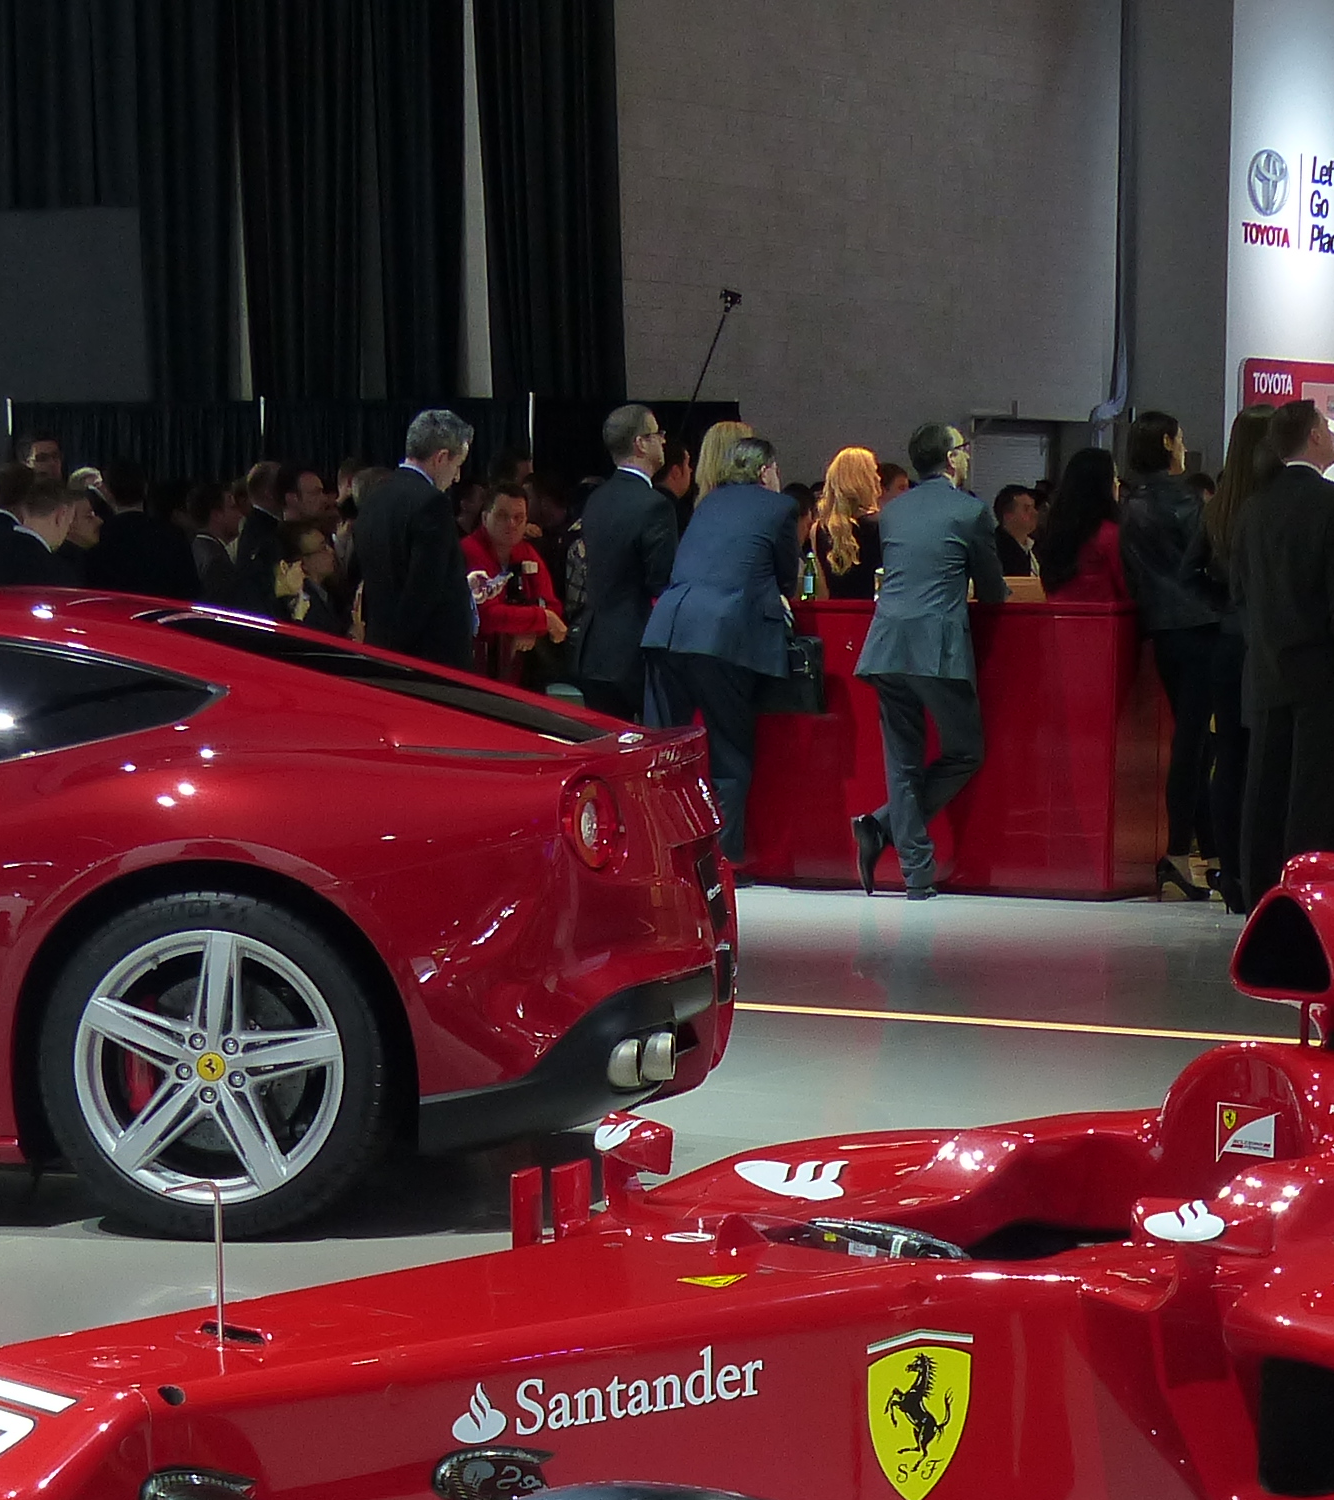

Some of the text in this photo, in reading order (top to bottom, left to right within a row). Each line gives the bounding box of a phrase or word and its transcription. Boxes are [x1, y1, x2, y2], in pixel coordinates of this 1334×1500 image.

[1310, 190, 1329, 218] Go
[1242, 221, 1290, 248] TOYOTA
[1253, 372, 1293, 395] TOYOTA
[515, 1345, 764, 1436] Santander
